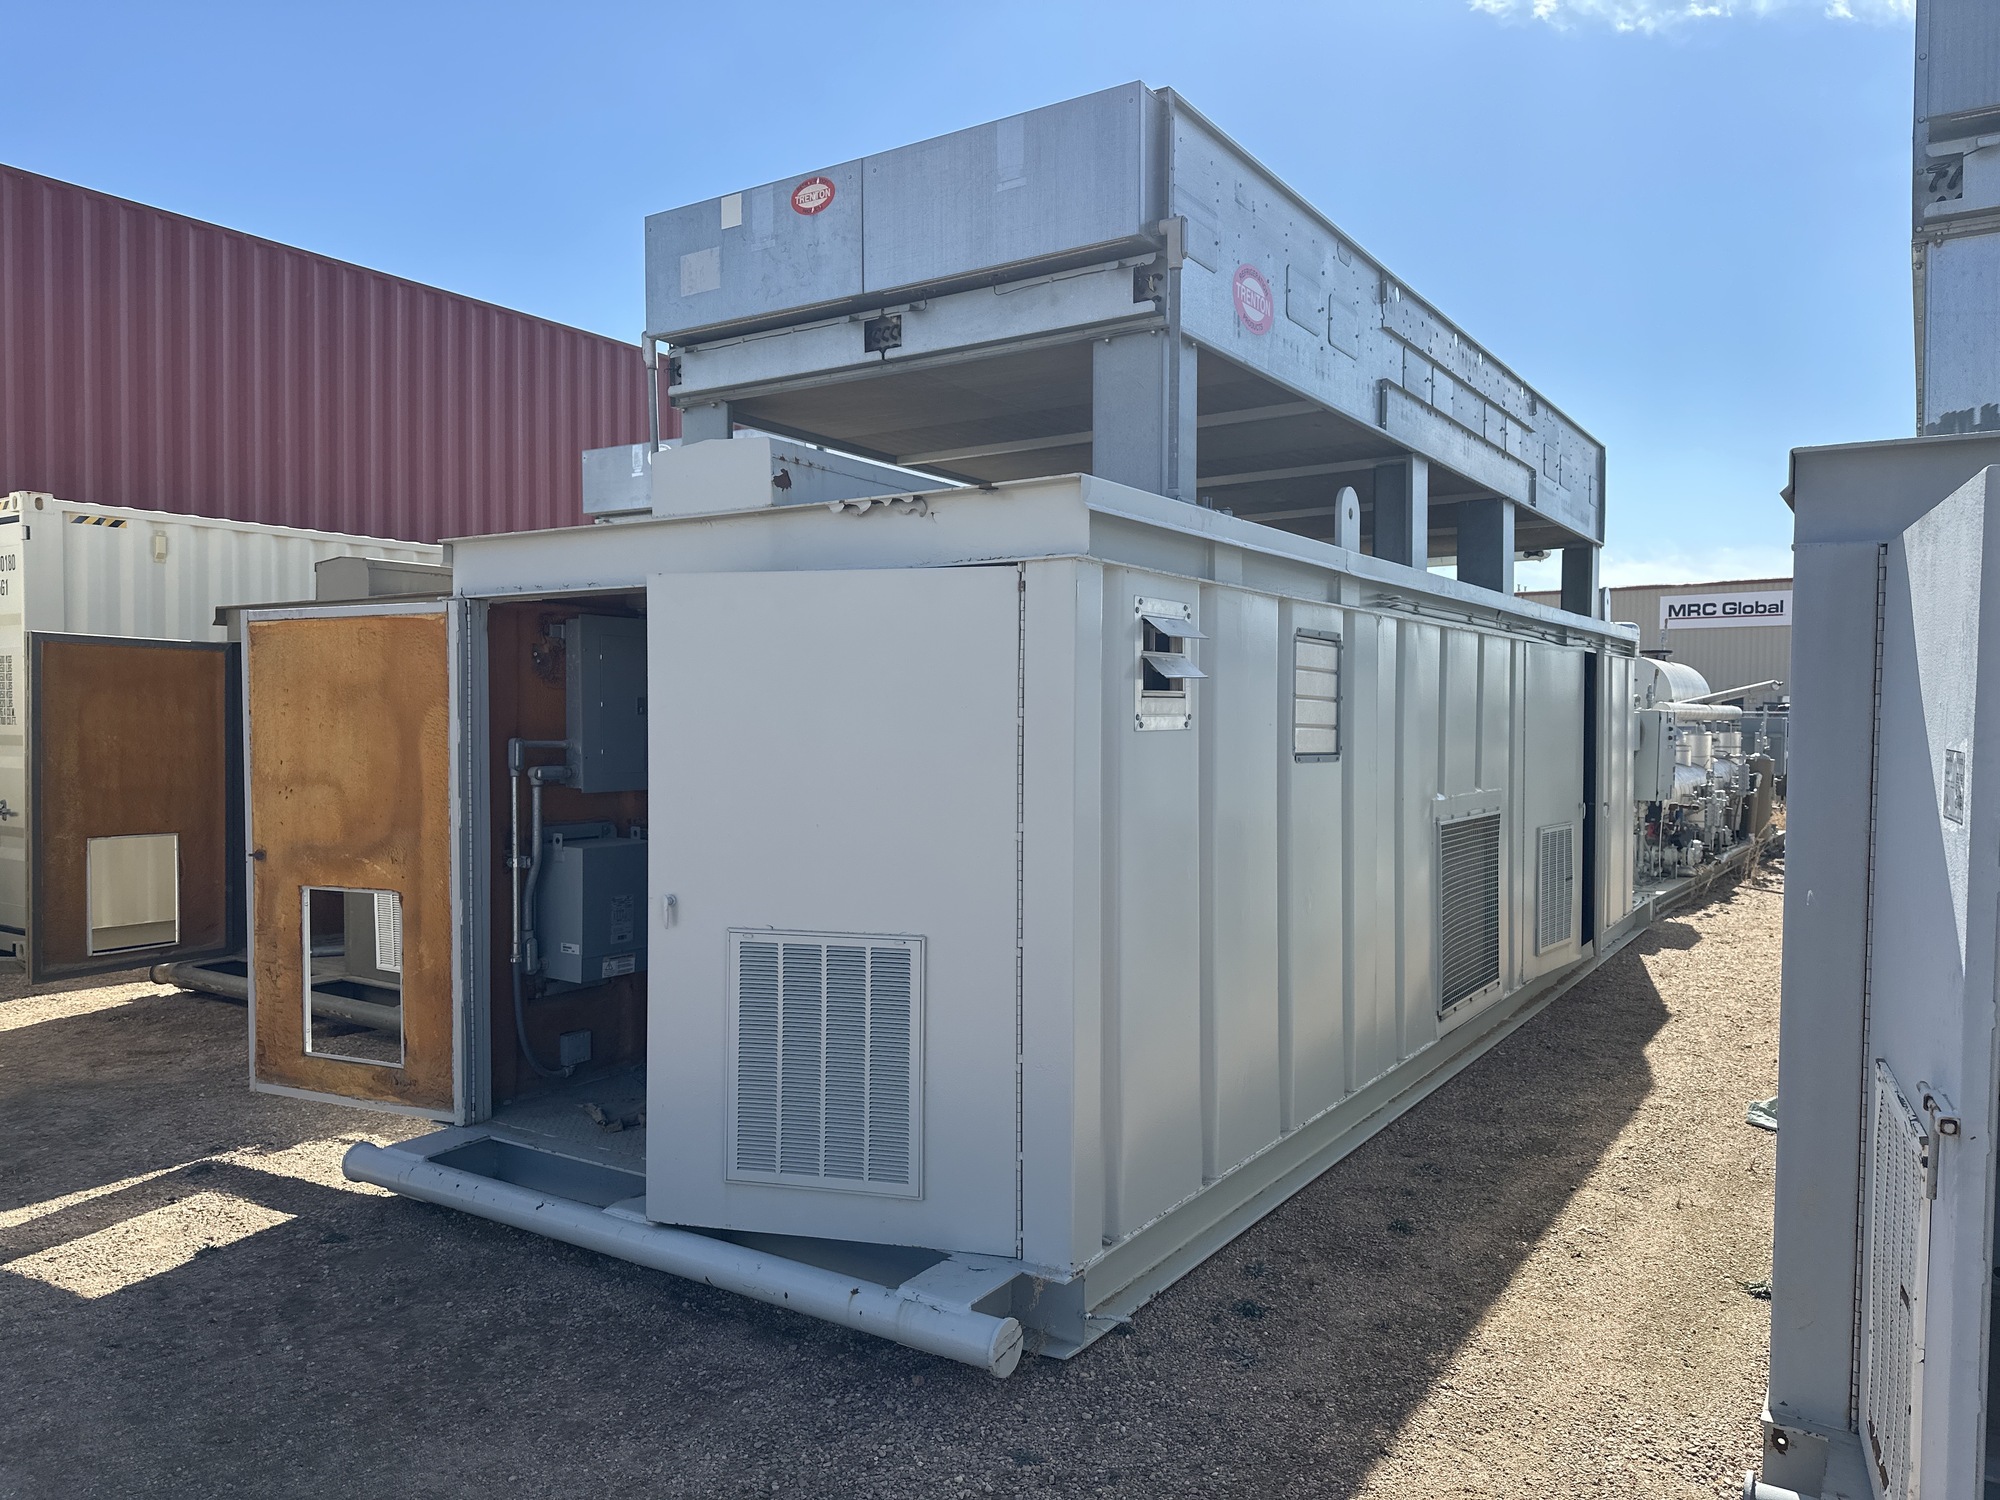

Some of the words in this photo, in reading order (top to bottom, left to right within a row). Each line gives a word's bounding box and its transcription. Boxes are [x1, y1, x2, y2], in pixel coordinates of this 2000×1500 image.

[795, 187, 831, 205] TRENTON
[1235, 281, 1271, 317] TRENTON
[1668, 602, 1717, 618] MRC
[1722, 599, 1784, 616] Global
